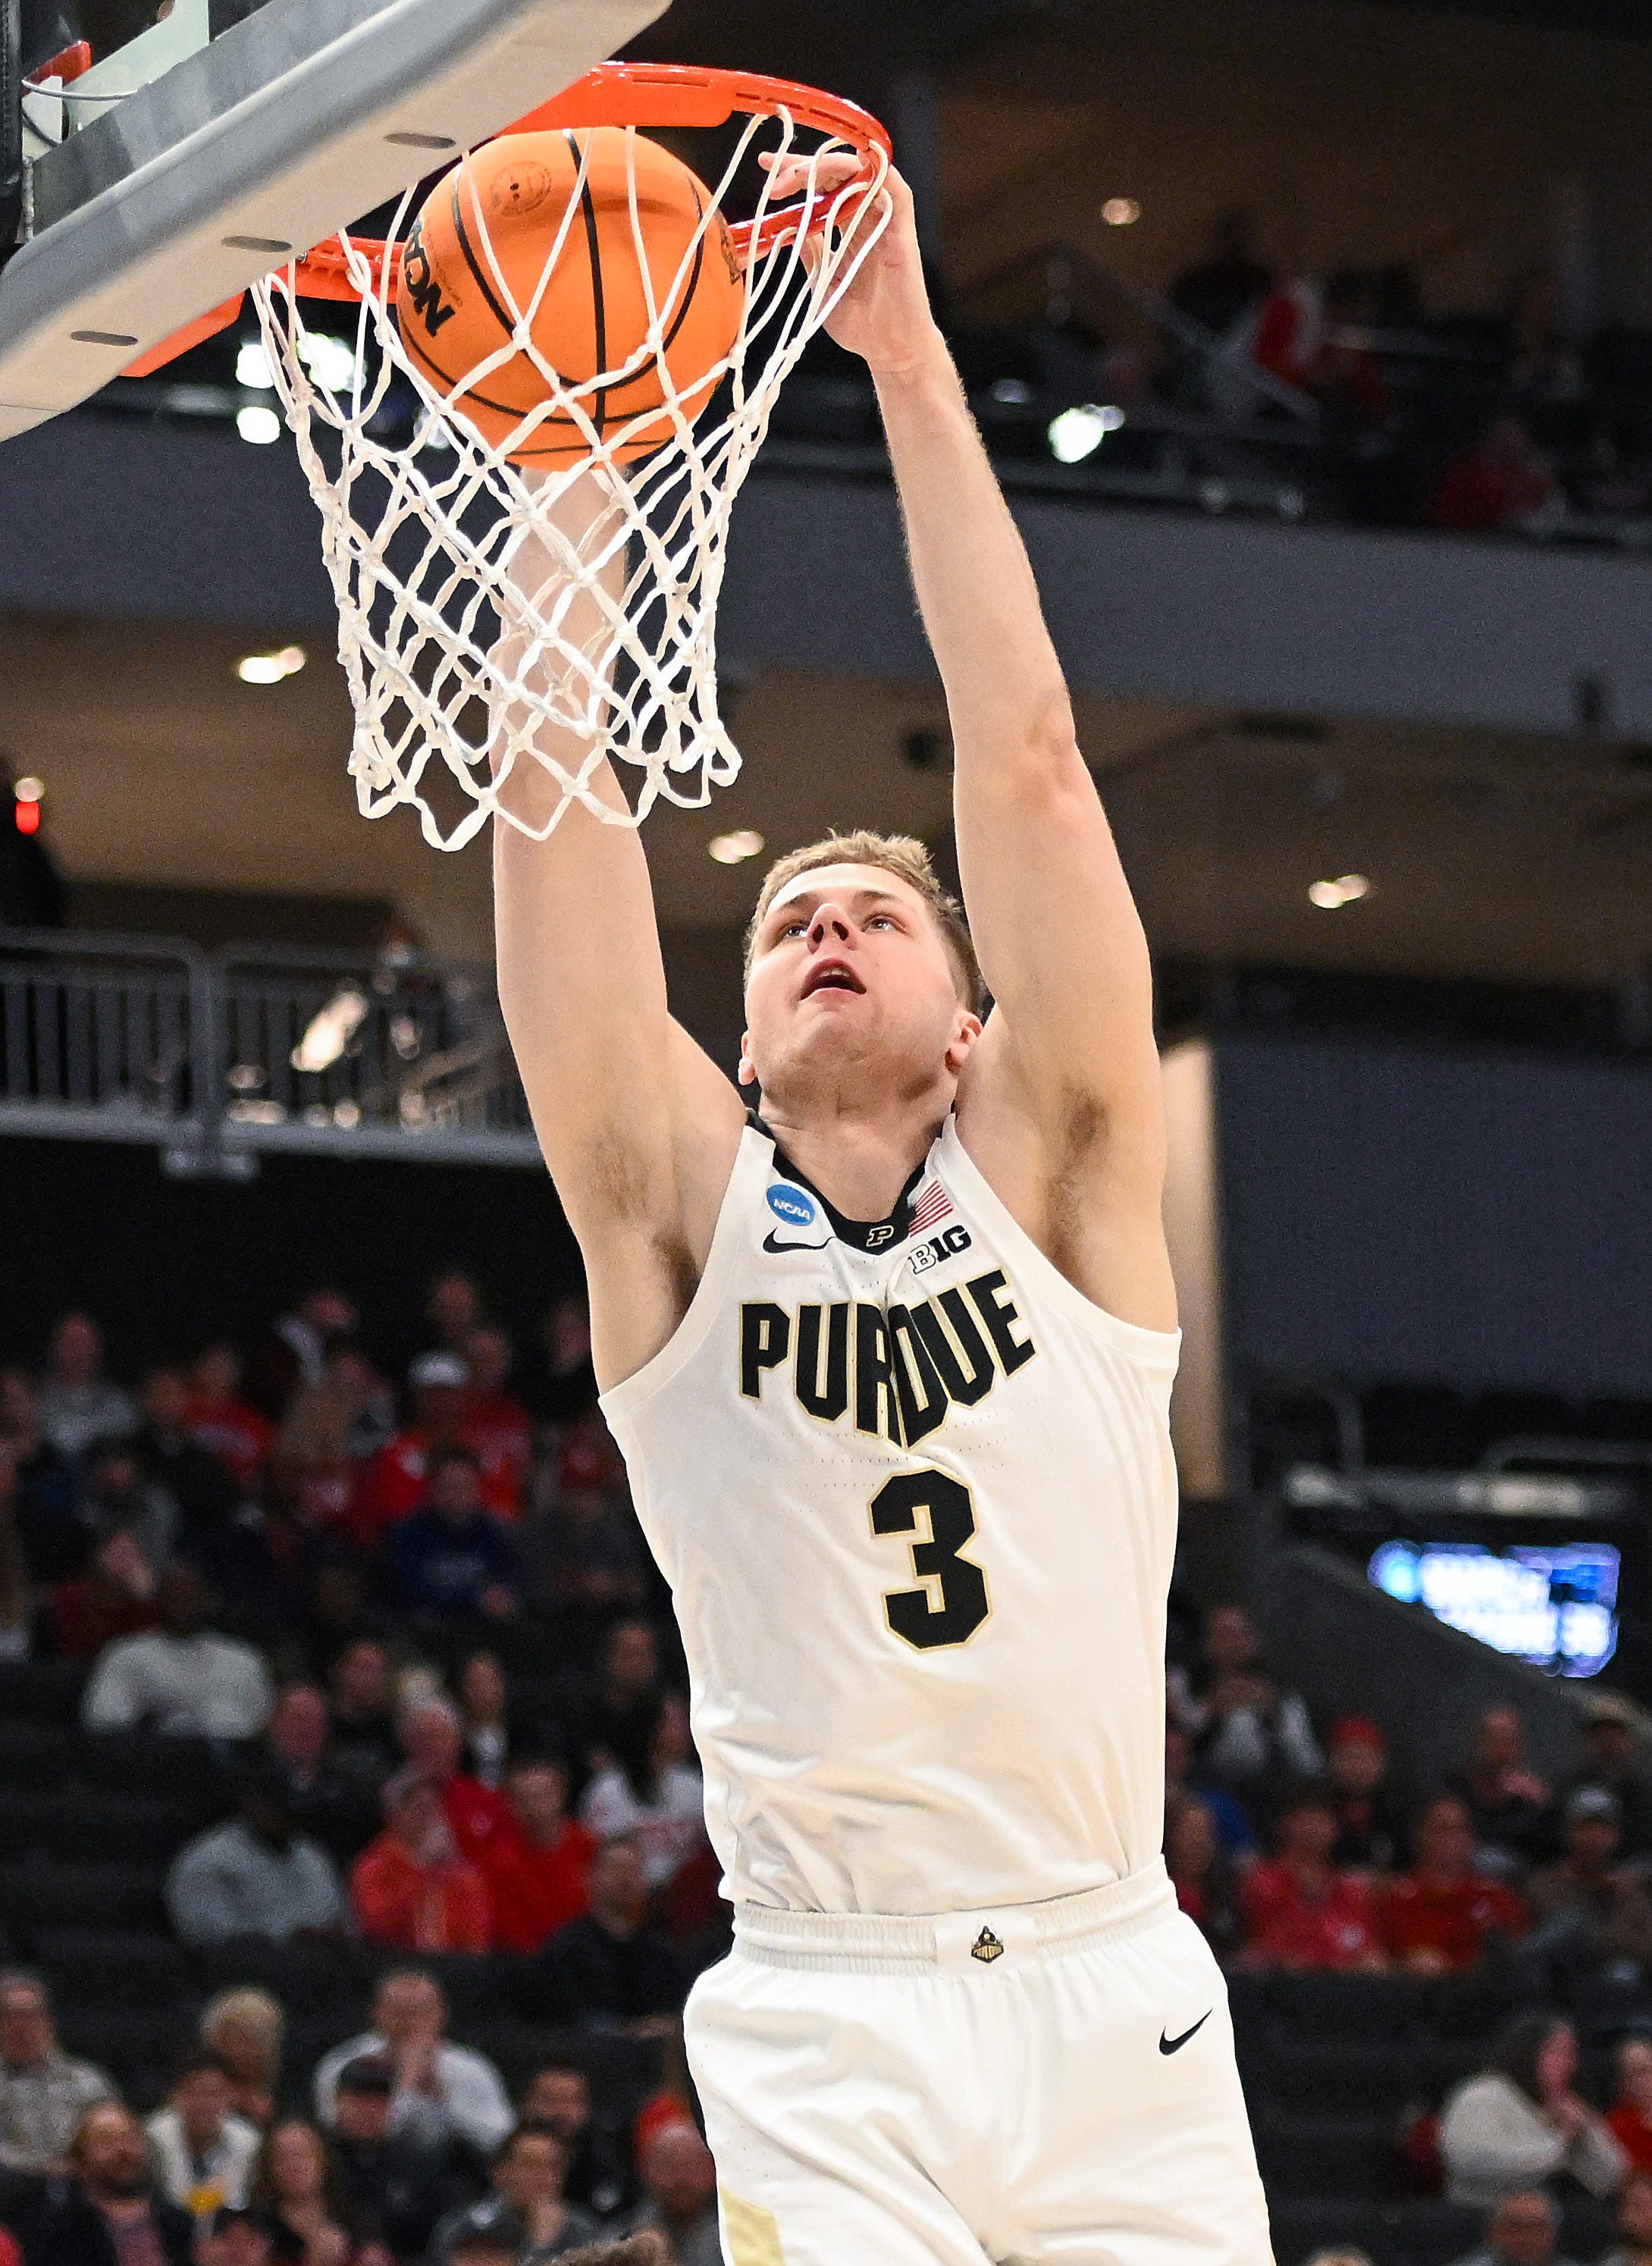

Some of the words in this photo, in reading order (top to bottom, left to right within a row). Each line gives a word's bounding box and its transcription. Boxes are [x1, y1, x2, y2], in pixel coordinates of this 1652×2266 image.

[773, 1198, 810, 1220] NCAA
[866, 1225, 894, 1248] P
[740, 1269, 1037, 1450] PURDUE
[868, 1467, 992, 1652] 3
